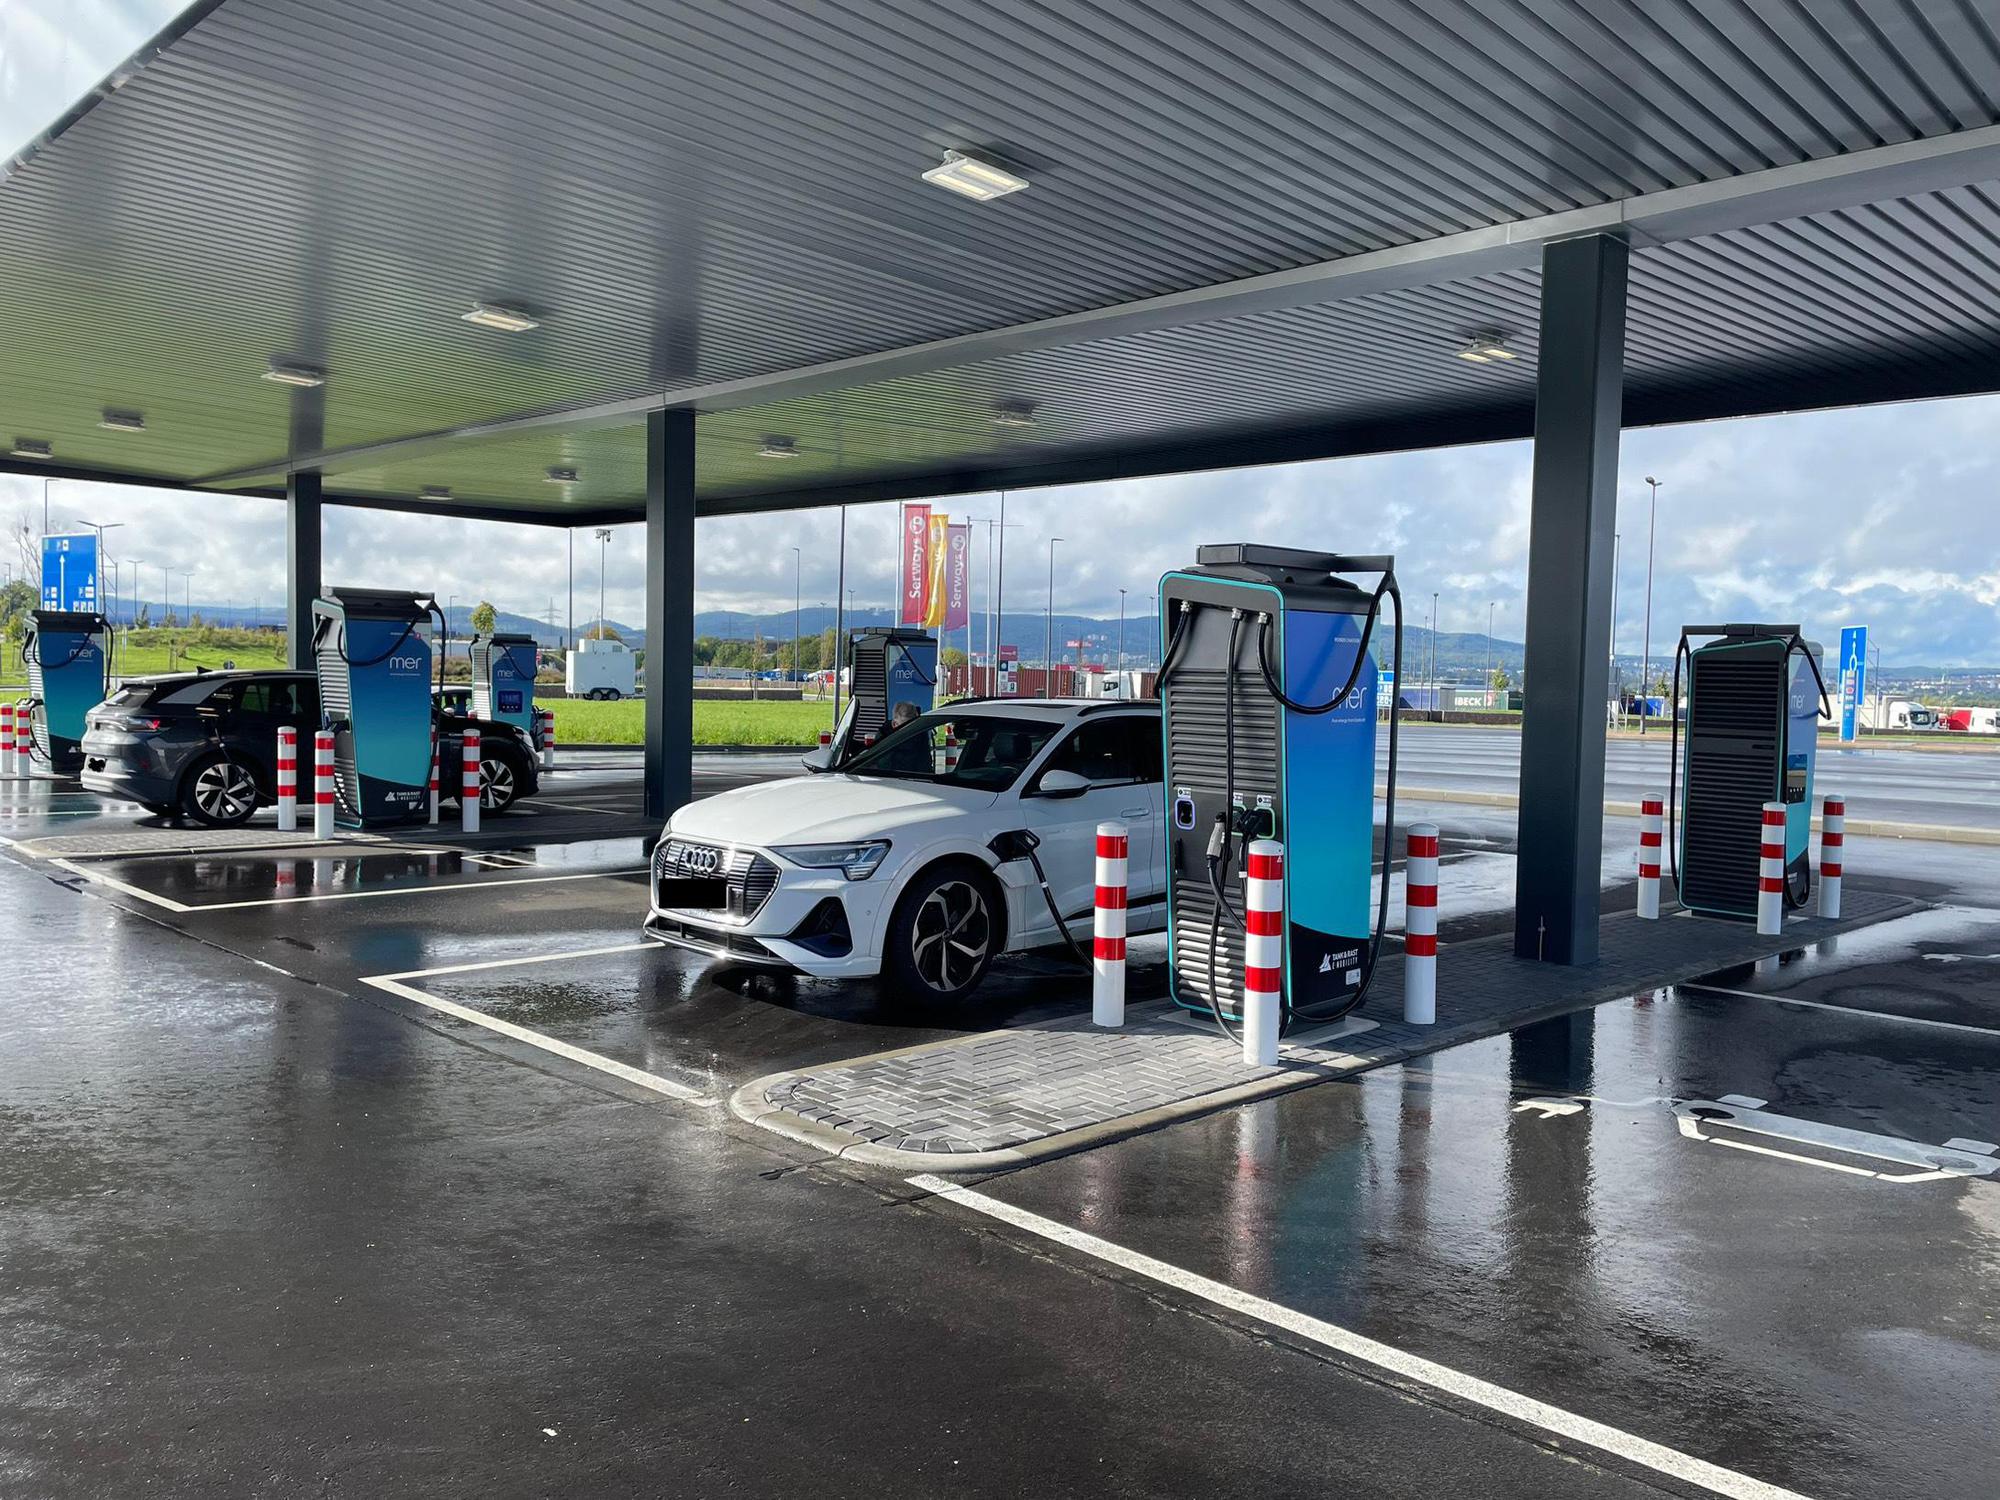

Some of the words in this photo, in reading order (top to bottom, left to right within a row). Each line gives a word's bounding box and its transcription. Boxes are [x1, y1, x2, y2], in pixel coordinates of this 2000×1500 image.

[390, 656, 422, 669] mer
[497, 669, 515, 678] mer
[896, 669, 914, 679] mer
